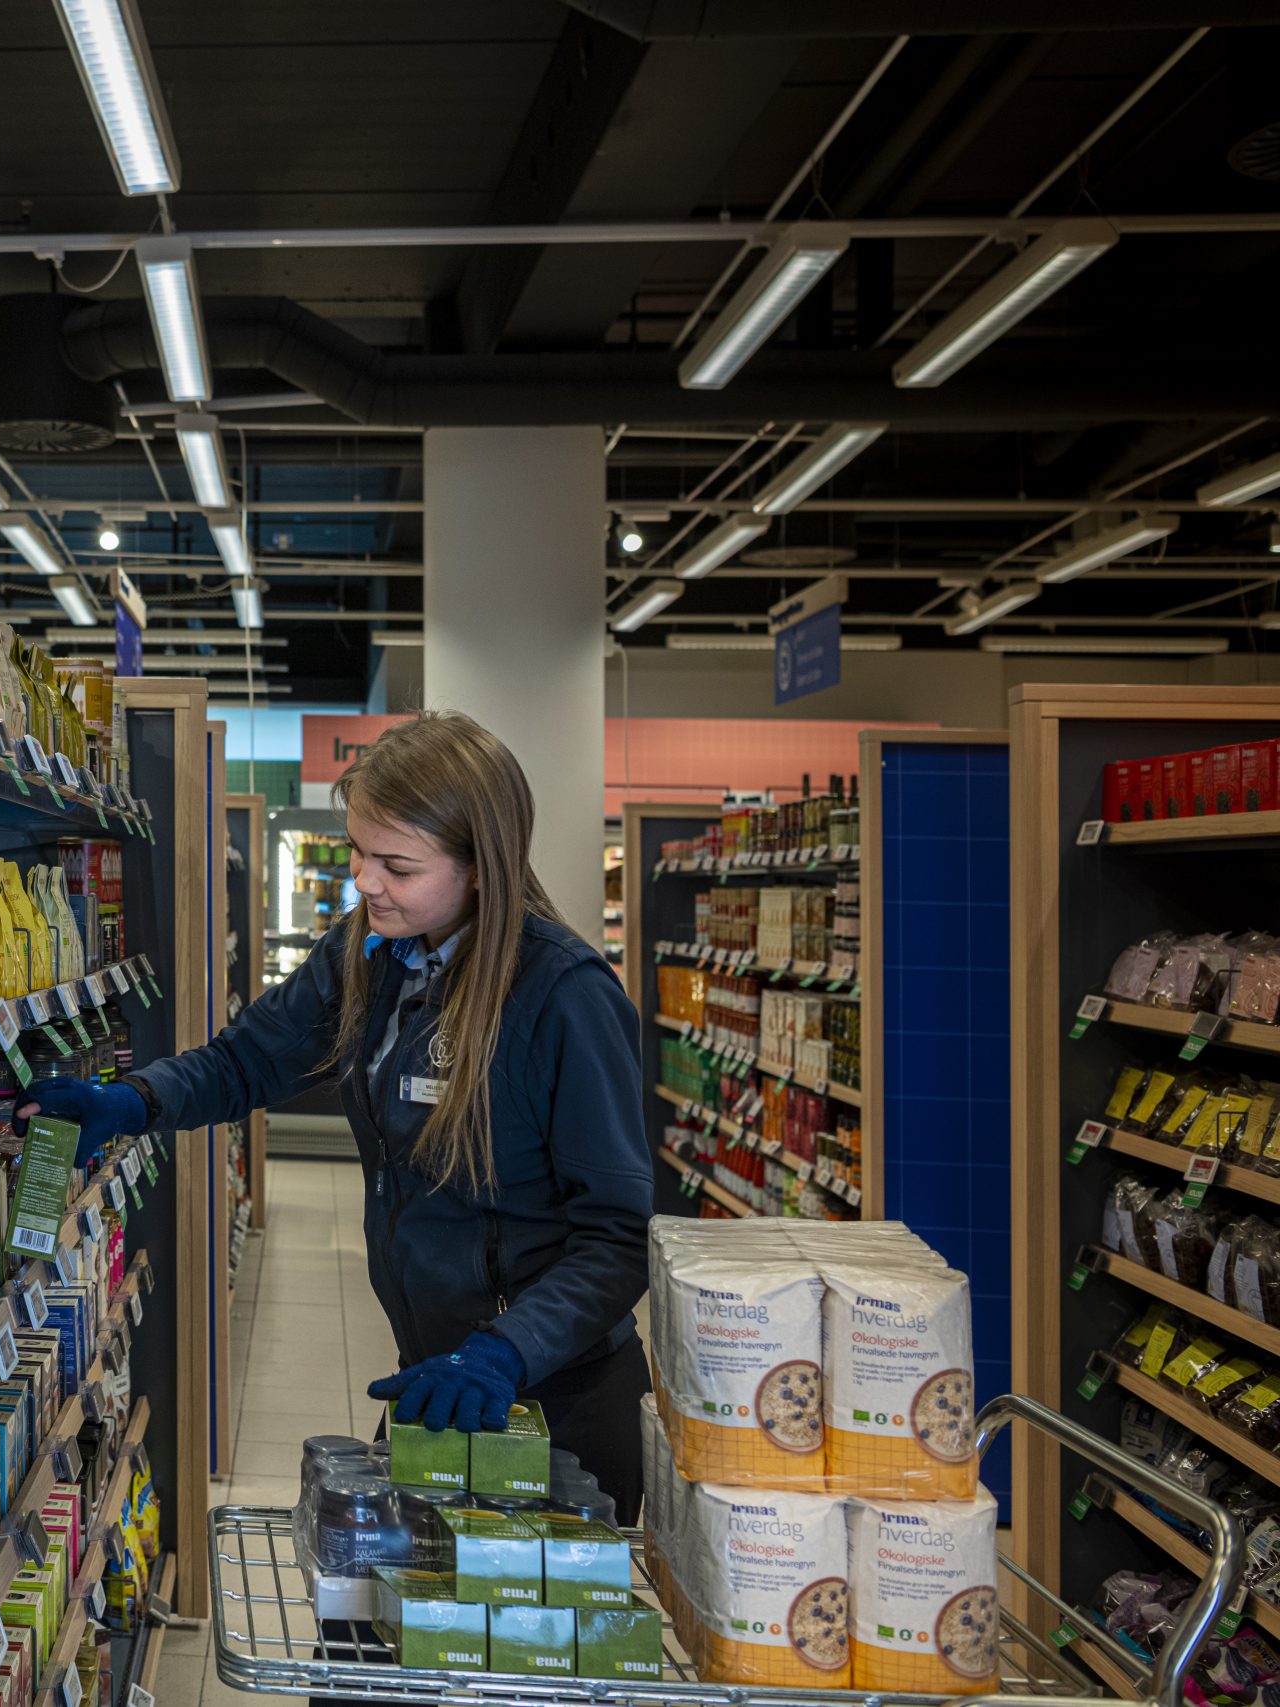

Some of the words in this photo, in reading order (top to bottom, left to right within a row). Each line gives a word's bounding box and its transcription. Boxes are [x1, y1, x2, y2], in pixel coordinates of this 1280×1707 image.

[699, 1288, 743, 1301] Irmas
[697, 1298, 769, 1324] hverdag
[856, 1296, 902, 1313] Irmas
[851, 1304, 928, 1333] hverdag
[697, 1324, 760, 1340] Økologiske
[697, 1337, 739, 1349] Finvalsede
[741, 1341, 783, 1352] havregryn
[852, 1331, 919, 1349] Økologiske
[852, 1345, 897, 1358] Finvalsede
[899, 1350, 939, 1361] havregryn
[424, 1472, 464, 1484] Irmas
[505, 1481, 545, 1493] Irmas
[731, 1503, 778, 1516] Irmas
[881, 1512, 928, 1526] Irmas
[728, 1513, 804, 1542] hverdag
[355, 1532, 381, 1542] Irma
[878, 1522, 955, 1552] hverdag
[729, 1540, 795, 1557] Økologiske
[729, 1553, 773, 1566] Finvalsede
[775, 1559, 816, 1570] havregryn
[878, 1548, 945, 1567] Økologiske
[878, 1561, 923, 1575] Finvalsede
[925, 1568, 966, 1578] havregryn
[493, 1587, 538, 1601] Irmas
[583, 1590, 627, 1604] Irmas
[438, 1651, 482, 1666] Irmas
[528, 1656, 571, 1670] Irmas
[615, 1661, 659, 1675] Irmas
